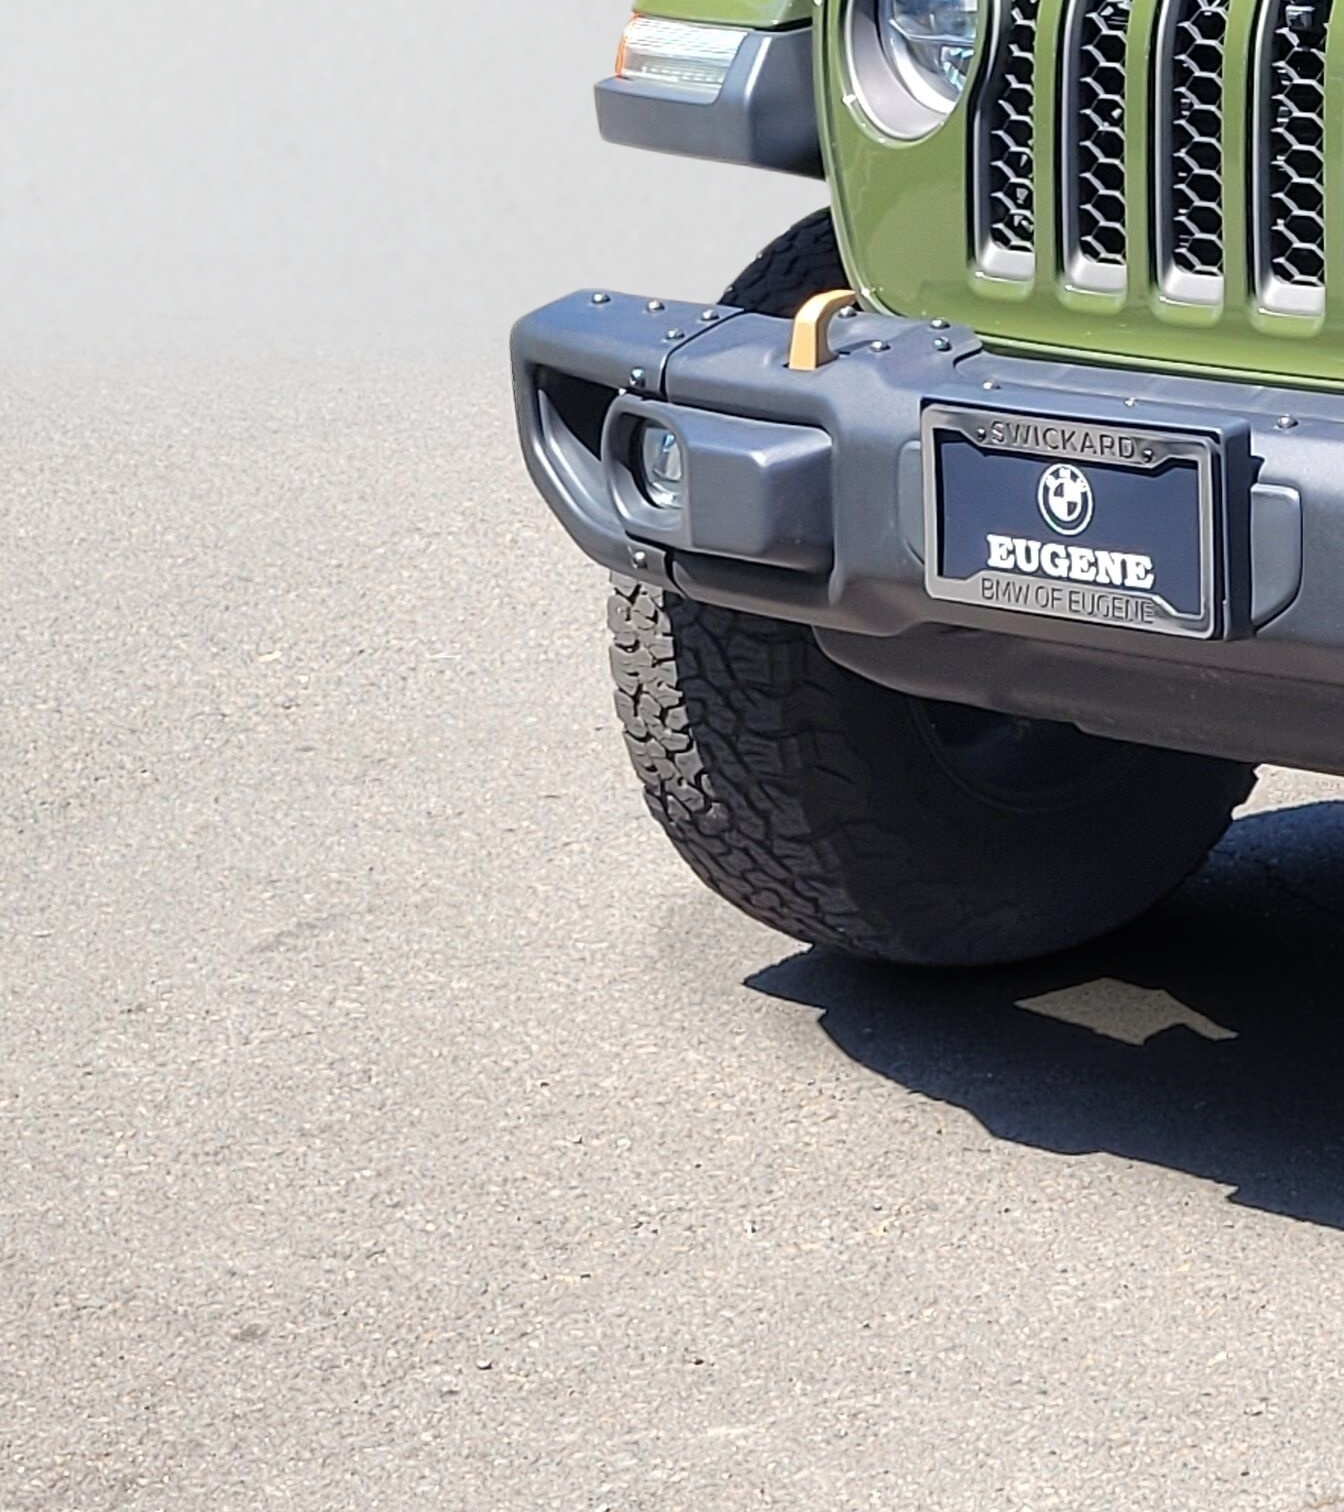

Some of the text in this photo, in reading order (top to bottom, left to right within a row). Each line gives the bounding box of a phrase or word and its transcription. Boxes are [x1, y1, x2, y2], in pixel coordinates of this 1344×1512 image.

[990, 420, 1136, 459] SWICKARD
[986, 534, 1156, 590] EUGENE
[981, 577, 1154, 624] BMW OF EUGENE
